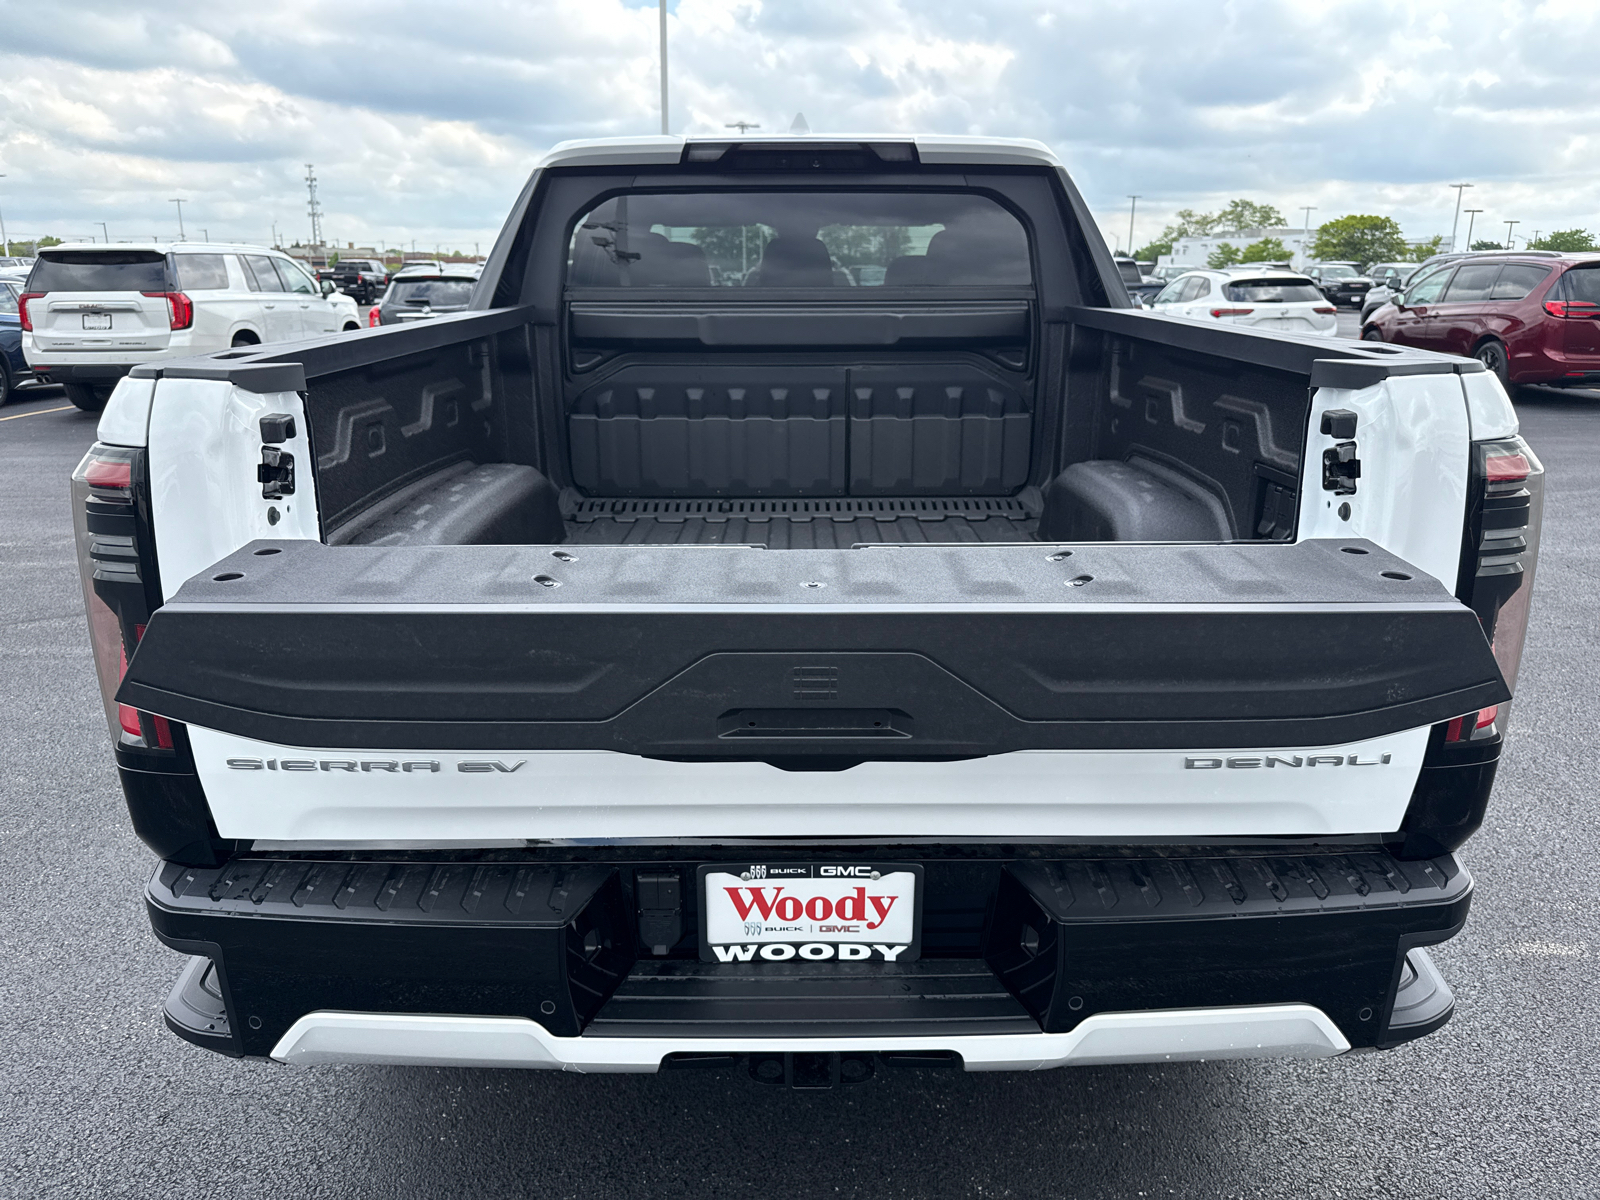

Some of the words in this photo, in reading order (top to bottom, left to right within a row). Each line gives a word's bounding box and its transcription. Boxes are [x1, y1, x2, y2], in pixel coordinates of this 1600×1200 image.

[226, 758, 440, 774] SIERRA
[456, 759, 527, 773] EV
[1184, 752, 1392, 769] DENALI
[820, 866, 872, 877] GMC
[722, 886, 899, 930] Woody
[819, 925, 860, 933] GMC
[711, 943, 909, 963] WOODY
